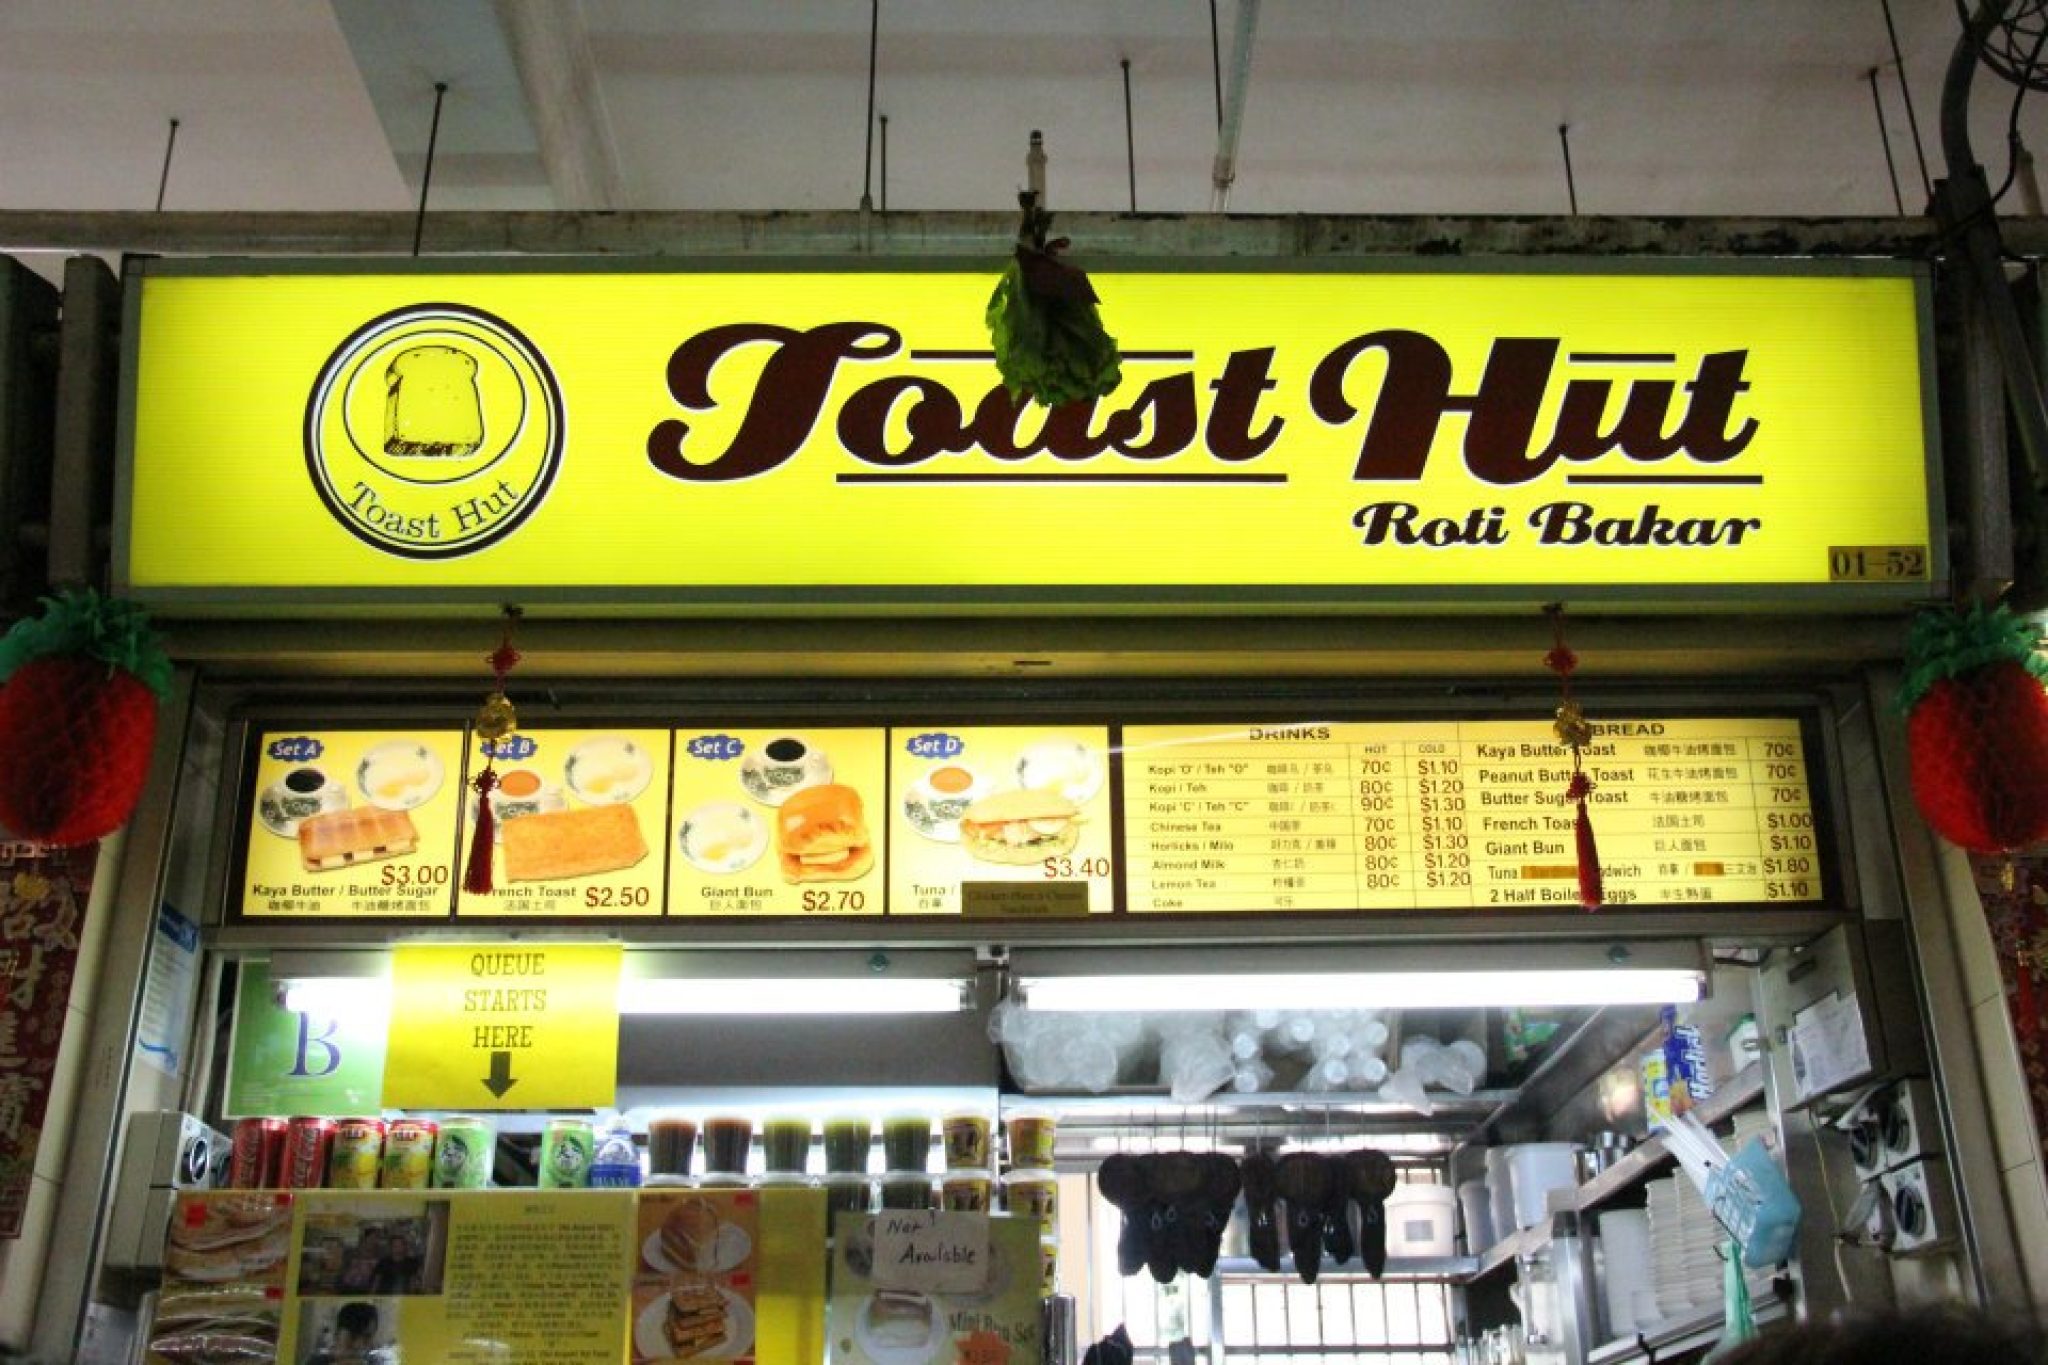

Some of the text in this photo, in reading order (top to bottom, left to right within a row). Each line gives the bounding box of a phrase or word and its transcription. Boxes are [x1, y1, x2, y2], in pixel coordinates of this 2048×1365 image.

[646, 321, 1761, 485] Toast Hut
[349, 480, 519, 538] Toast Hut
[1352, 500, 1762, 548] Roti Bakar
[1831, 551, 1924, 578] 01-52
[1250, 726, 1331, 741] DRINKS
[1592, 724, 1665, 737] BREAD
[275, 742, 317, 756] Set A
[486, 741, 514, 754] et
[694, 740, 737, 754] Set C
[912, 738, 958, 753] Set D
[1476, 743, 1617, 761] Kaya Butter oast
[1148, 764, 1176, 777] Kopi
[1418, 758, 1458, 775] $1.10
[1479, 767, 1635, 783] Peanut Butt Toast
[1419, 778, 1464, 795] $1.20
[1420, 796, 1466, 813] $1.30
[1481, 790, 1529, 805] Butter
[1149, 802, 1177, 815] Kopi
[1206, 801, 1226, 813] Teh
[1151, 820, 1222, 833] Chinese Tea
[1422, 816, 1463, 833] $1.10
[1482, 816, 1539, 831] French
[1767, 812, 1813, 829] $1.00
[1151, 840, 1200, 851] Horlicks
[1209, 840, 1234, 851] Milo
[1422, 833, 1469, 851] $1.30
[1486, 840, 1565, 856] Giant Bun
[1770, 836, 1811, 852] $1.10
[1044, 857, 1111, 879] $3.40
[1152, 858, 1226, 870] Almond Milk
[1425, 852, 1471, 870] $1.20
[381, 864, 449, 886] $3.00
[1427, 871, 1472, 888] $1.20
[1487, 865, 1518, 880] Tuna
[252, 884, 287, 899] Kaya
[292, 884, 336, 897] Butter
[348, 884, 393, 897] Butter
[396, 884, 438, 899] Sugar
[492, 885, 577, 898] rench Toast
[912, 884, 946, 896] Tuna
[1151, 877, 1217, 890] Lemon Tea
[1768, 882, 1809, 899] $1.10
[585, 886, 650, 909] $2.50
[701, 886, 774, 898] Giant Bun
[1490, 889, 1499, 903] 2
[1504, 888, 1536, 902] Half
[1541, 887, 1580, 902] Boile
[802, 889, 865, 912] $2.70
[1152, 897, 1183, 909] Coke
[470, 953, 545, 978] QUEUE
[464, 989, 547, 1012] STARTS
[472, 1026, 534, 1048] HERE
